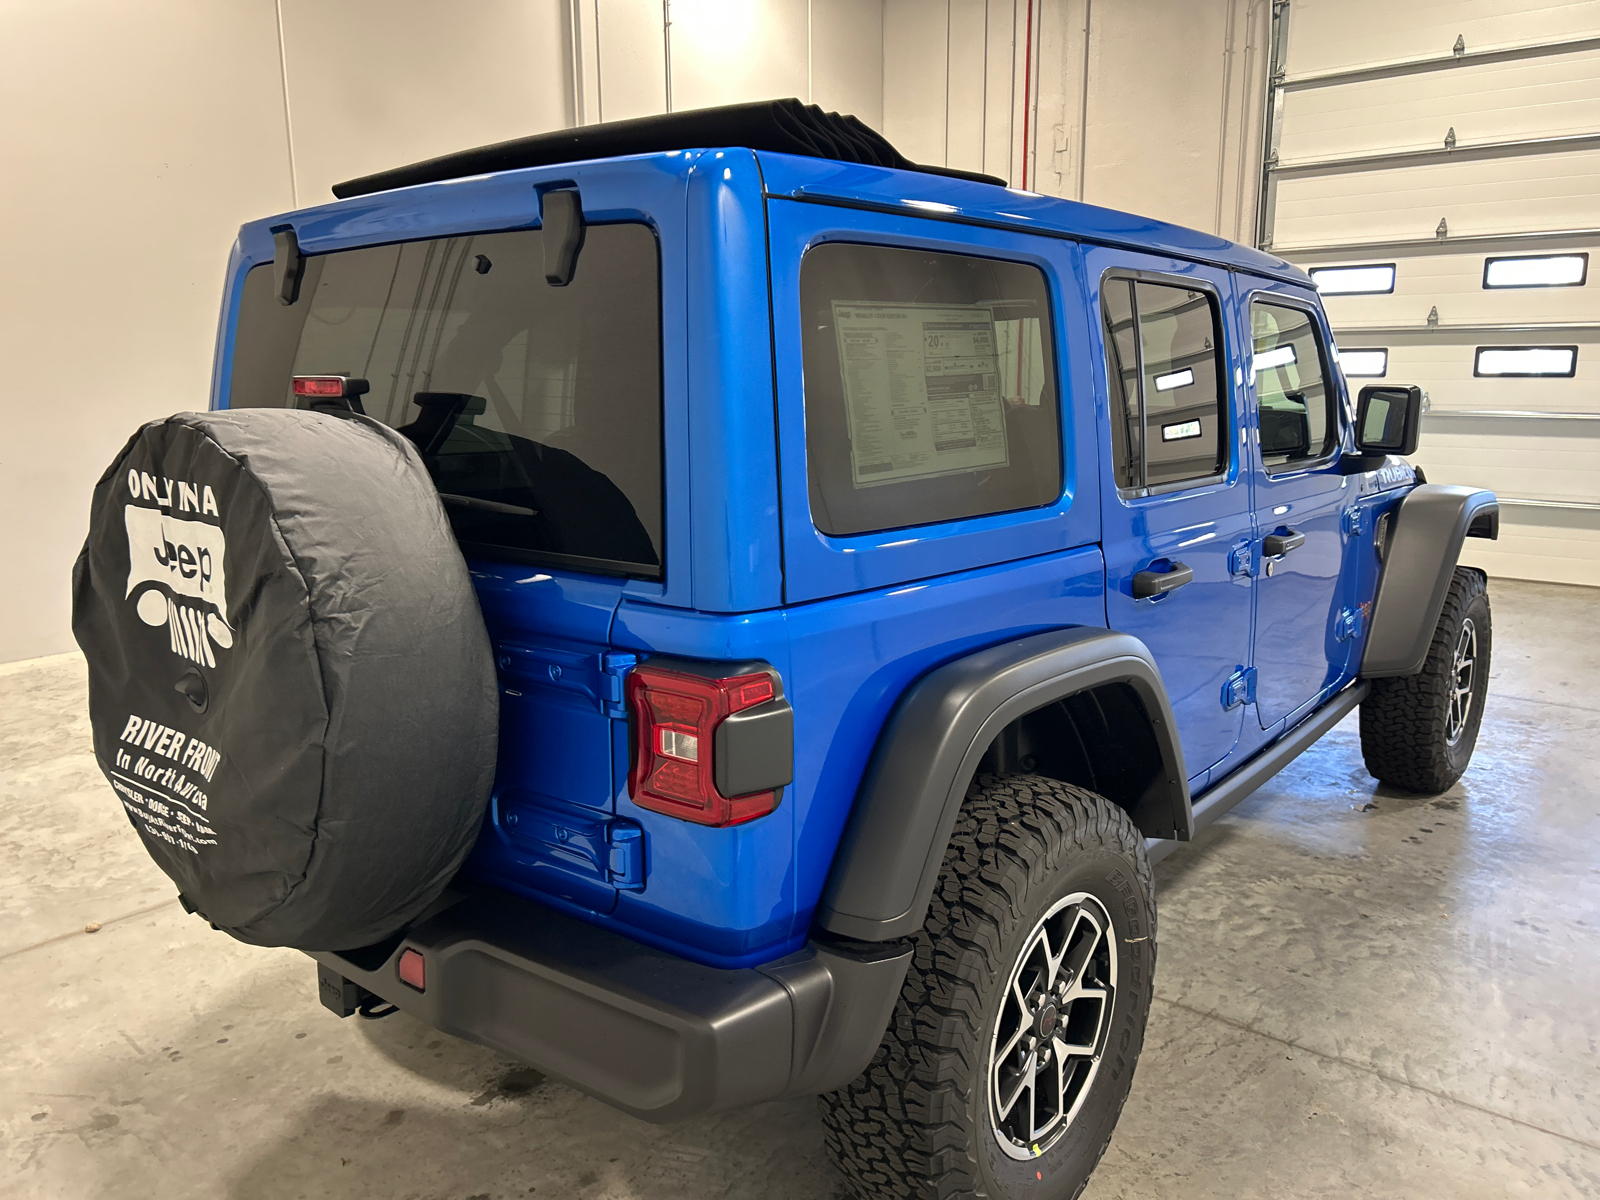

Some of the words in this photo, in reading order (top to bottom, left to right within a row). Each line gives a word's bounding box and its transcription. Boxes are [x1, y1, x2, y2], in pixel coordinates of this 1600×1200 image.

[928, 334, 939, 348] 20
[203, 485, 219, 517] A
[116, 747, 132, 771] In
[119, 714, 186, 762] RIVER
[182, 738, 221, 783] FRONT
[113, 779, 145, 804] CSLER
[1105, 868, 1142, 1081] BFGoodrich
